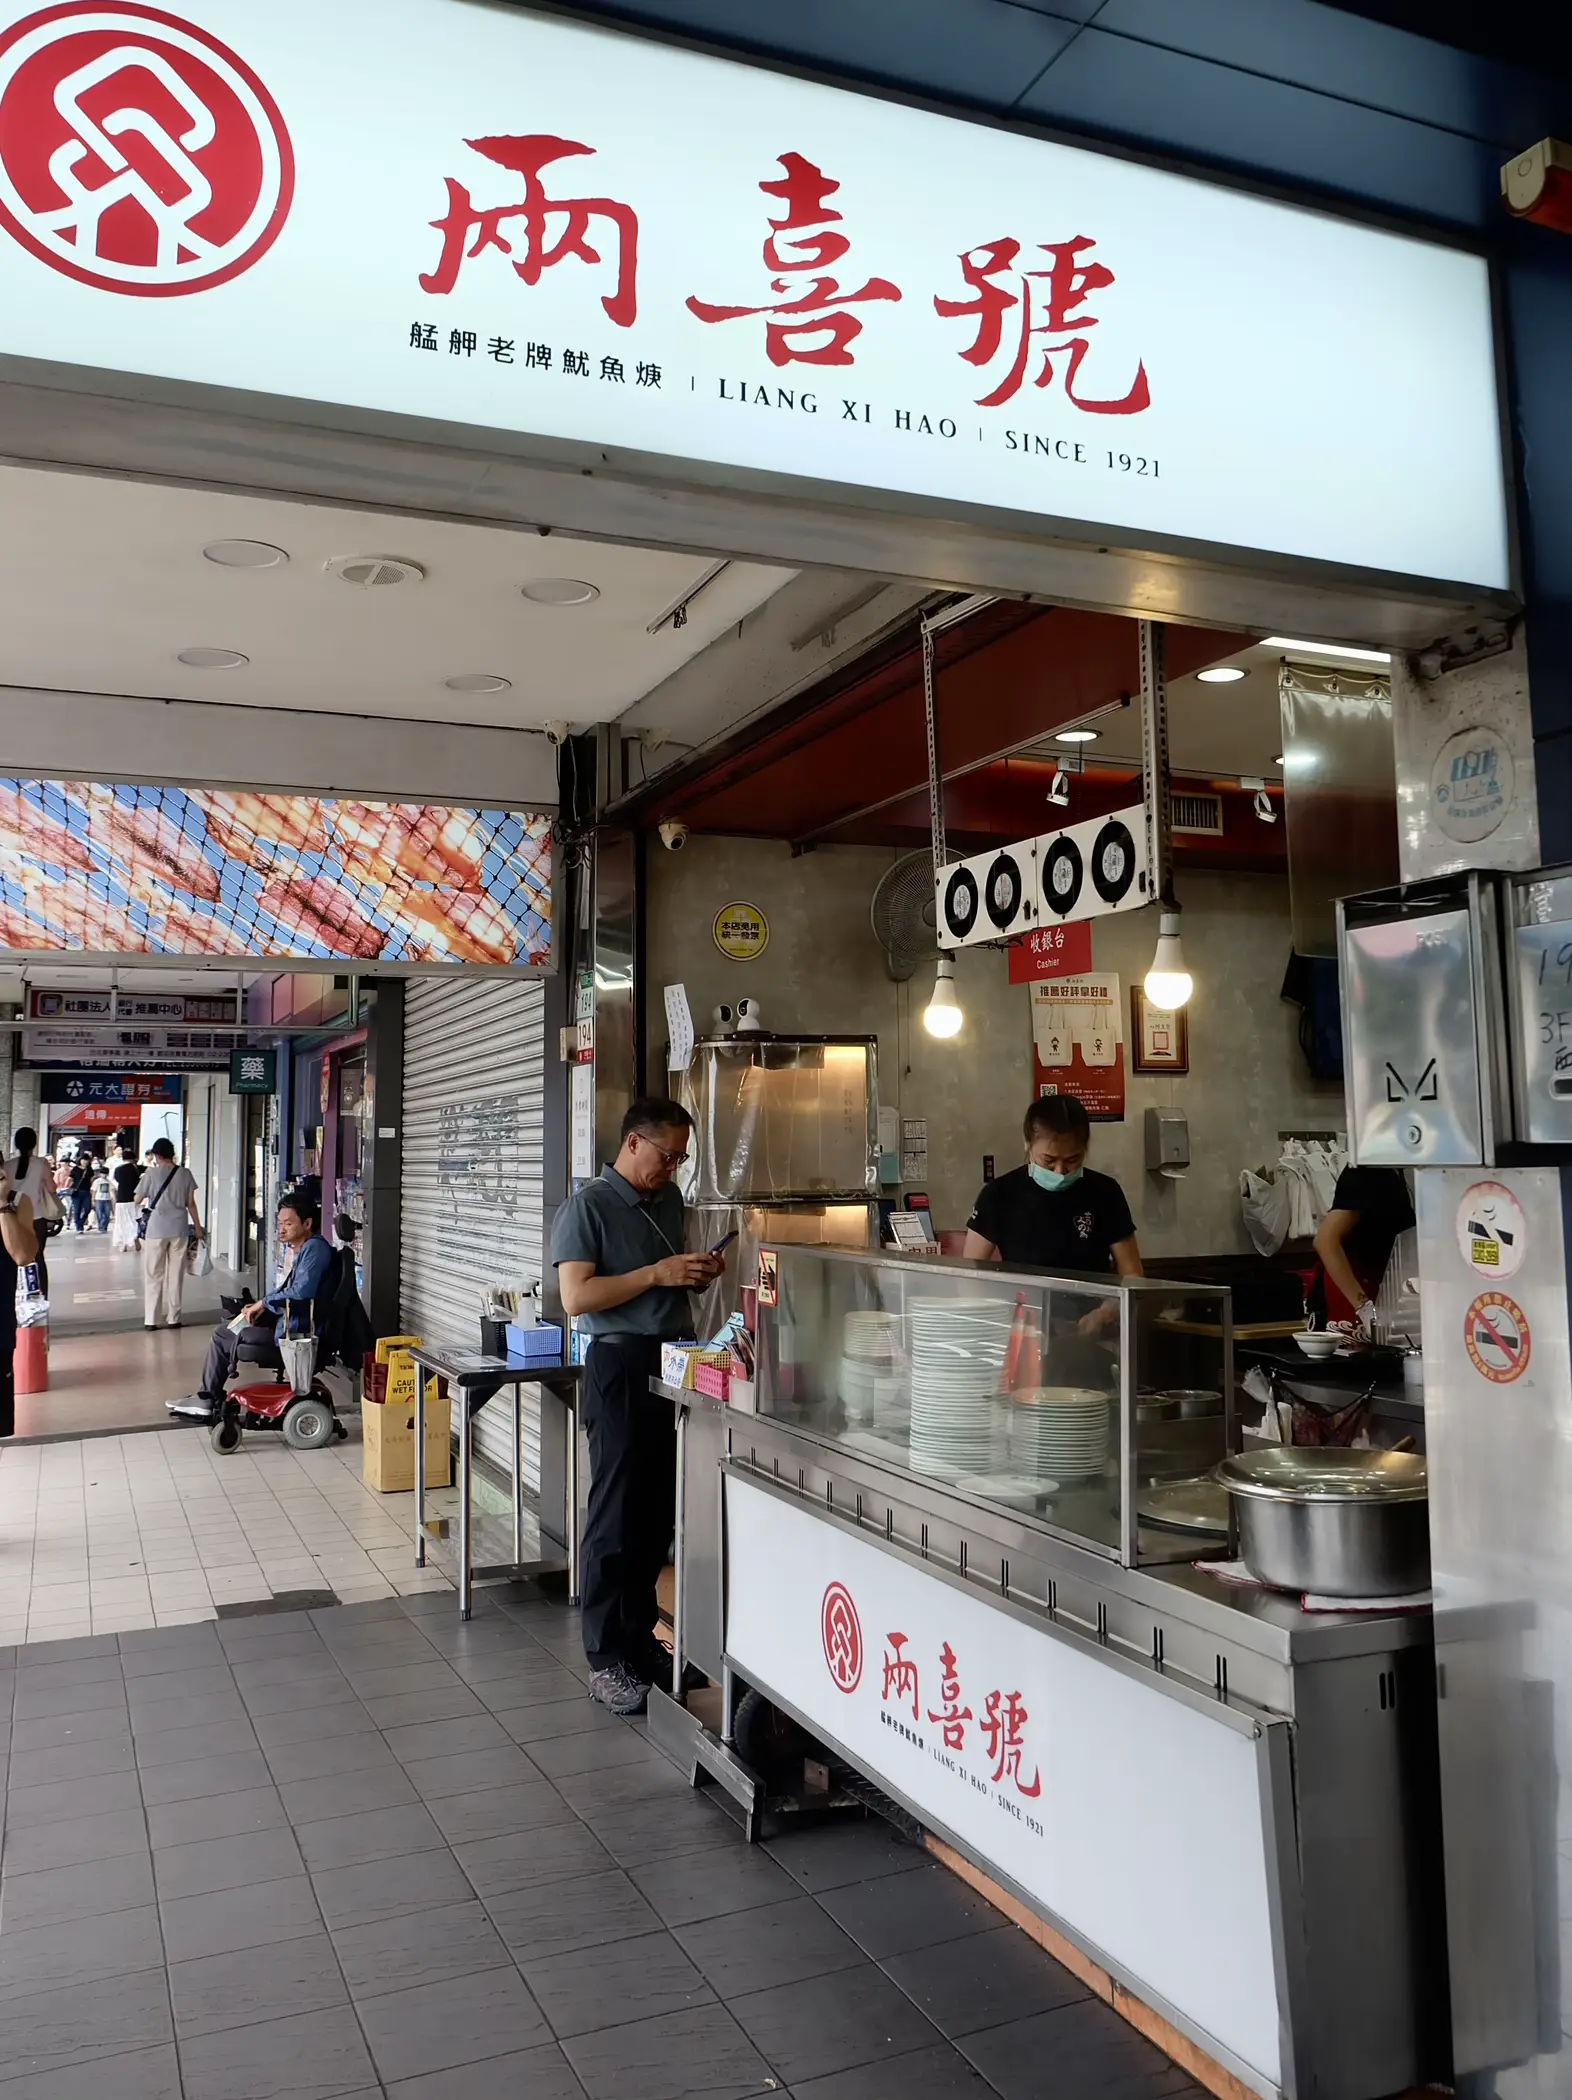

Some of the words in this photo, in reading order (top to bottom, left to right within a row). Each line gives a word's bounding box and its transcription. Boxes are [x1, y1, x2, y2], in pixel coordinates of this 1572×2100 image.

[419, 135, 1150, 414] 兩喜號
[410, 321, 662, 389] 艋舺老牌魷魚焿
[719, 378, 818, 413] LIANG
[842, 400, 871, 423] XI
[895, 410, 957, 438] HAO
[1005, 430, 1087, 463] SINCE
[1107, 451, 1160, 478] 1921
[1030, 927, 1065, 953] 收銀台
[1036, 957, 1060, 970] Cashier
[581, 992, 592, 1012] 194
[579, 1023, 592, 1046] 194
[241, 1057, 264, 1080] 藥
[89, 1083, 151, 1096] 元大證券
[235, 1081, 268, 1089] Pharmacy
[392, 1386, 406, 1394] WET
[882, 1632, 1041, 1798] 兩喜號
[933, 1748, 956, 1772] LIANG
[959, 1766, 967, 1781] XI
[971, 1775, 987, 1795] HAO
[998, 1795, 1022, 1821] SINCE
[1026, 1815, 1044, 1837] 1921
